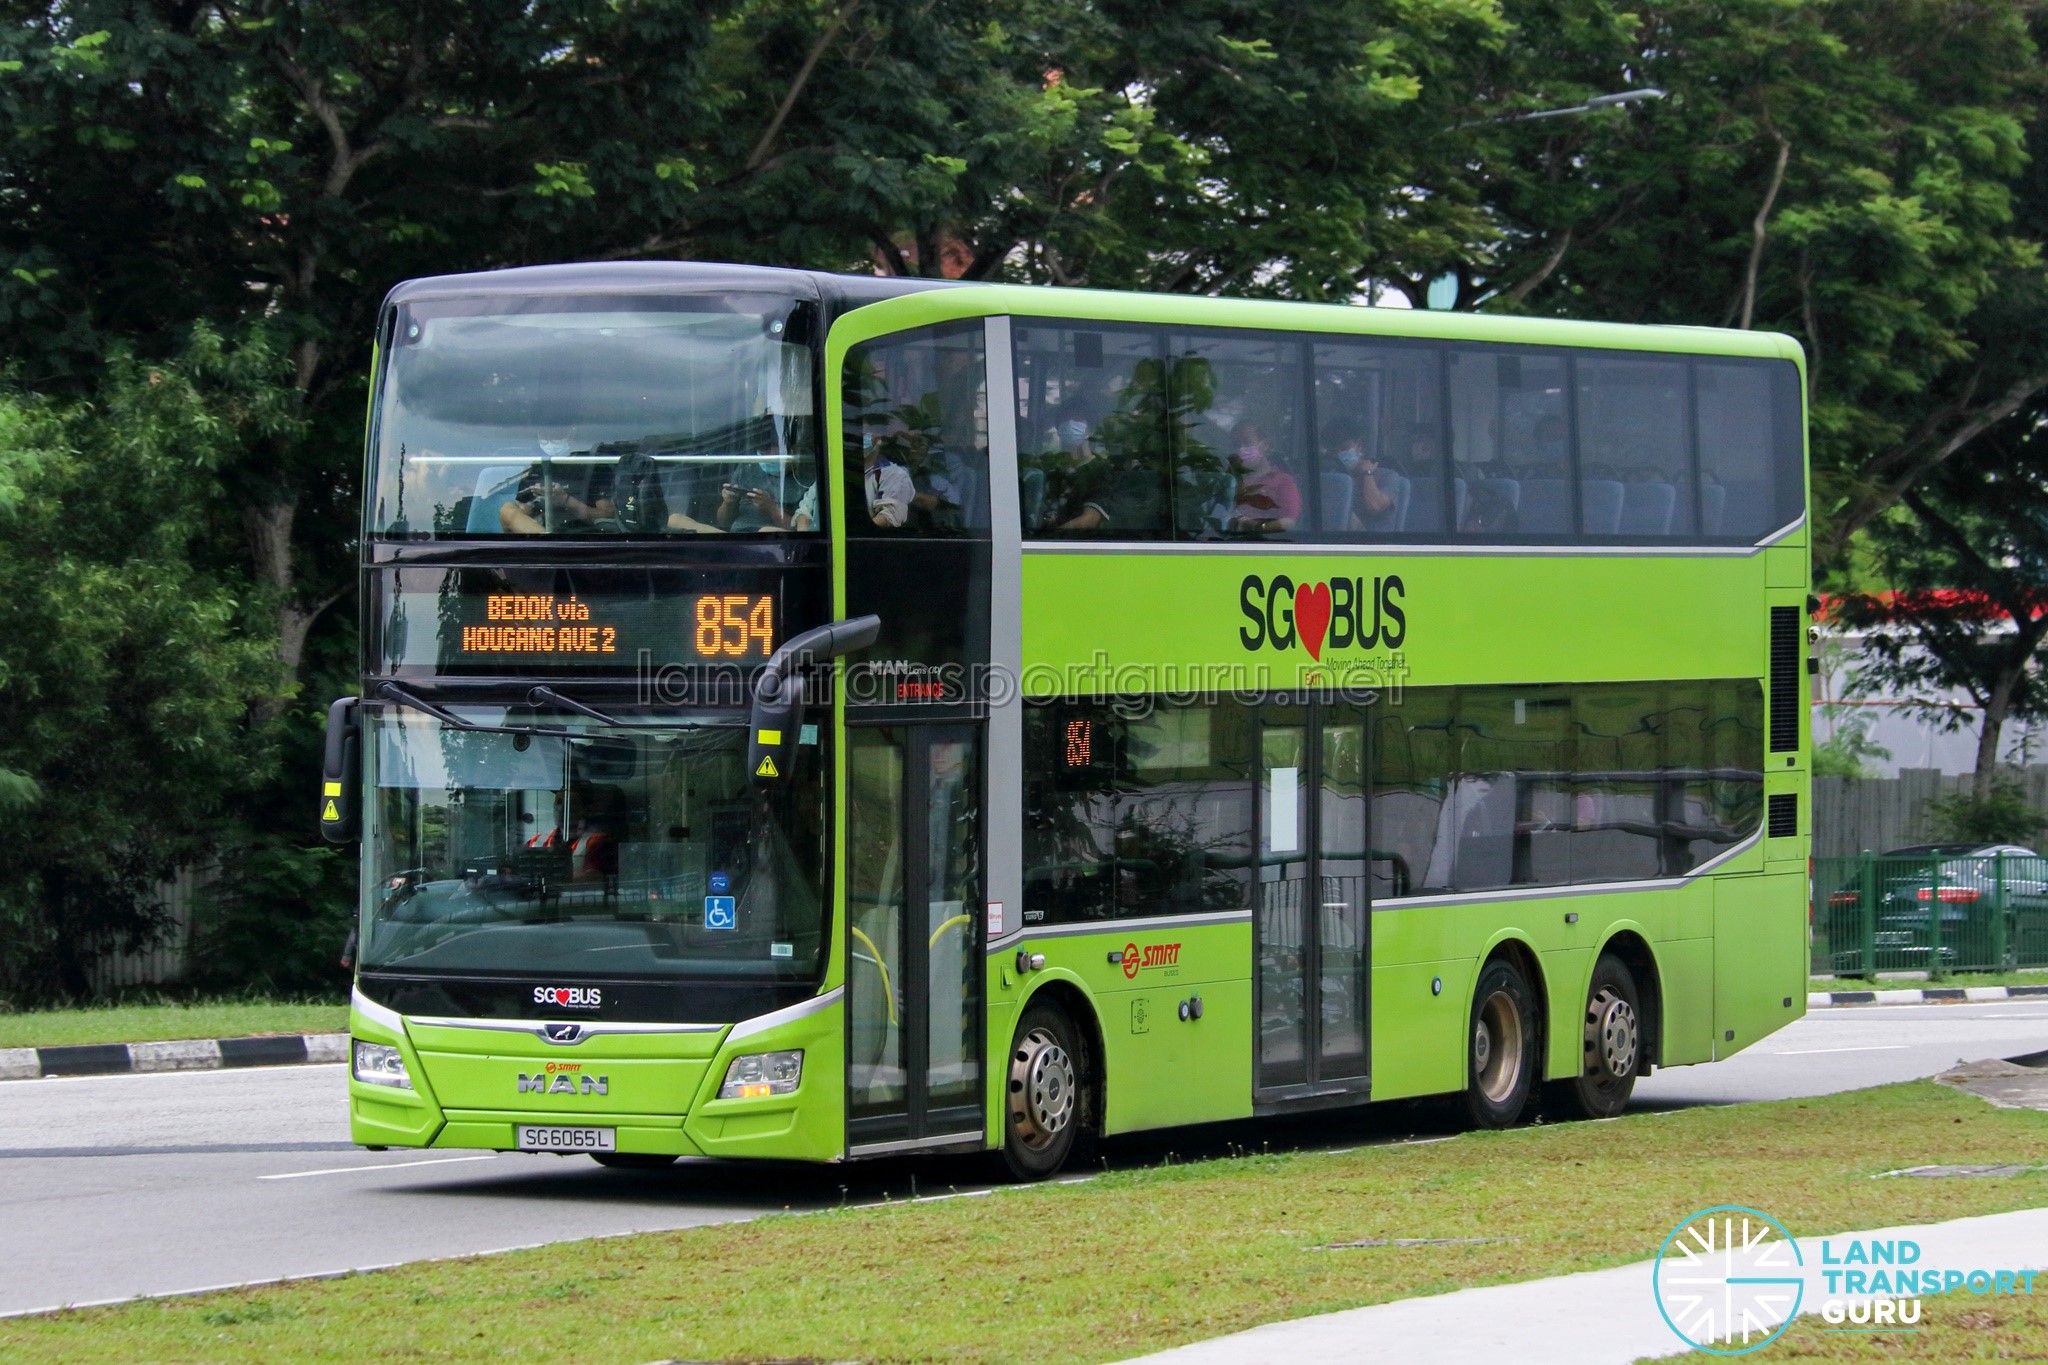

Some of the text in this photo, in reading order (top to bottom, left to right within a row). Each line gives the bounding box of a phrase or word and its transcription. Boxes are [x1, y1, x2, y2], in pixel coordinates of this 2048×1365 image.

[487, 596, 590, 620] BEDOK via
[696, 596, 773, 655] 854
[463, 627, 616, 652] HOUGANG AVE 2
[869, 659, 908, 675] MAN
[1325, 656, 1352, 674] Moving
[1353, 656, 1376, 670] Ahead
[1305, 672, 1321, 686] EXIT
[897, 682, 945, 698] ENTRANCE
[1067, 721, 1090, 766] 854
[1141, 943, 1182, 967] SMRT
[557, 1063, 582, 1072] SMRT
[518, 1073, 609, 1096] MAN
[525, 1129, 609, 1148] SG6065L
